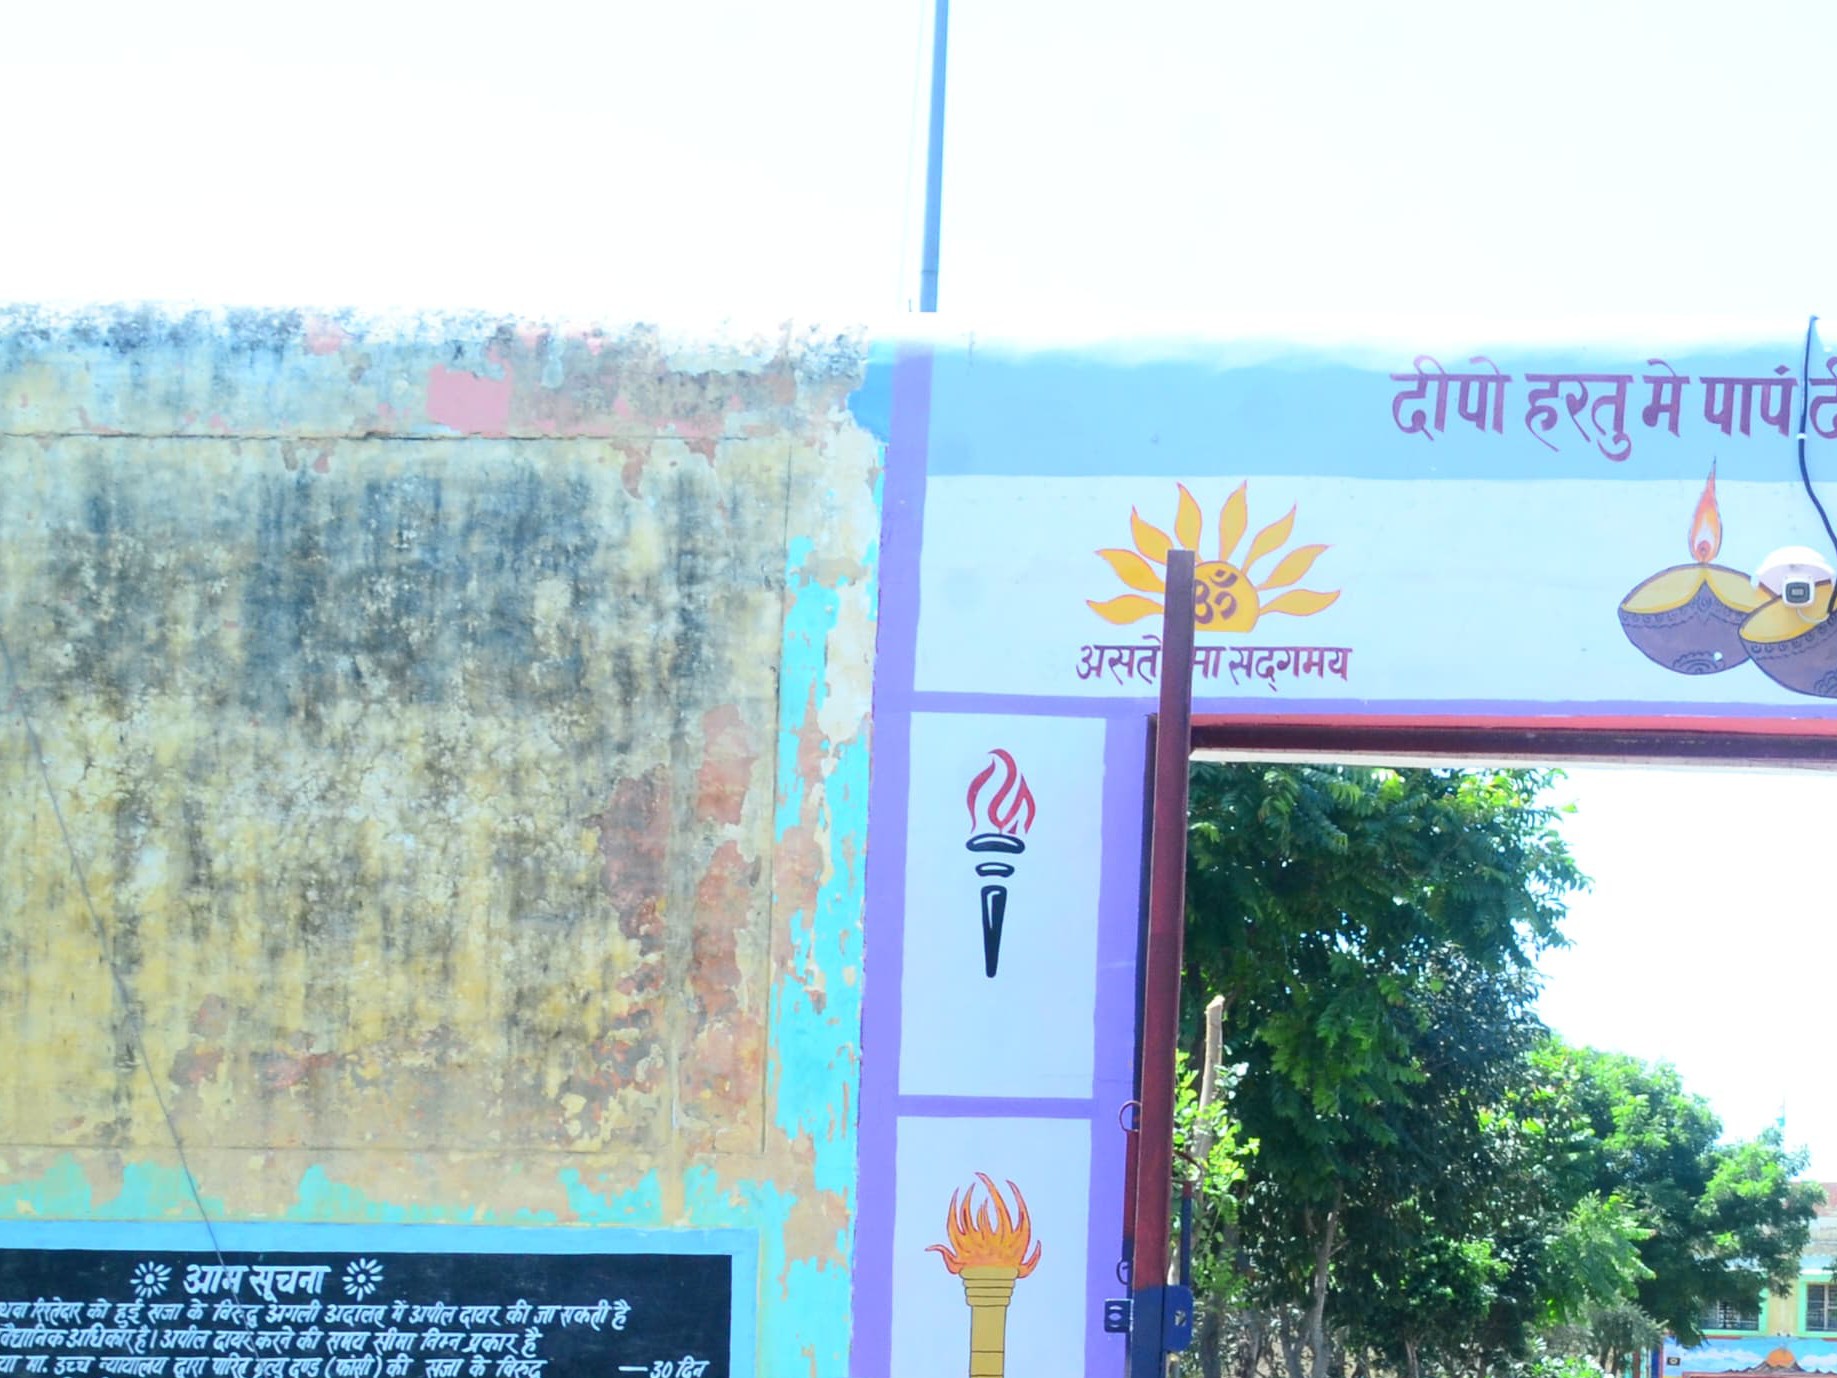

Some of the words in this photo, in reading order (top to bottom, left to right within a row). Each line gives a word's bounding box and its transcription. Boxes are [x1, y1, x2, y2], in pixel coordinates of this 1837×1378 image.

[1389, 354, 1512, 441] दीपो
[1524, 372, 1634, 462] हरतु
[1642, 358, 1691, 437] मे
[1699, 364, 1798, 437] पापं
[183, 1264, 249, 1295] आम
[249, 1264, 332, 1302] सूचना
[147, 1303, 185, 1324] सजा
[186, 1298, 209, 1320] के
[264, 1299, 322, 1323] अगली
[409, 1301, 458, 1326] अपील
[506, 1299, 533, 1324] की
[533, 1305, 562, 1324] जा
[611, 1300, 631, 1330] है
[160, 1325, 212, 1350] अपील
[521, 1326, 543, 1358] है
[386, 1353, 414, 1378] की
[468, 1354, 492, 1378] के
